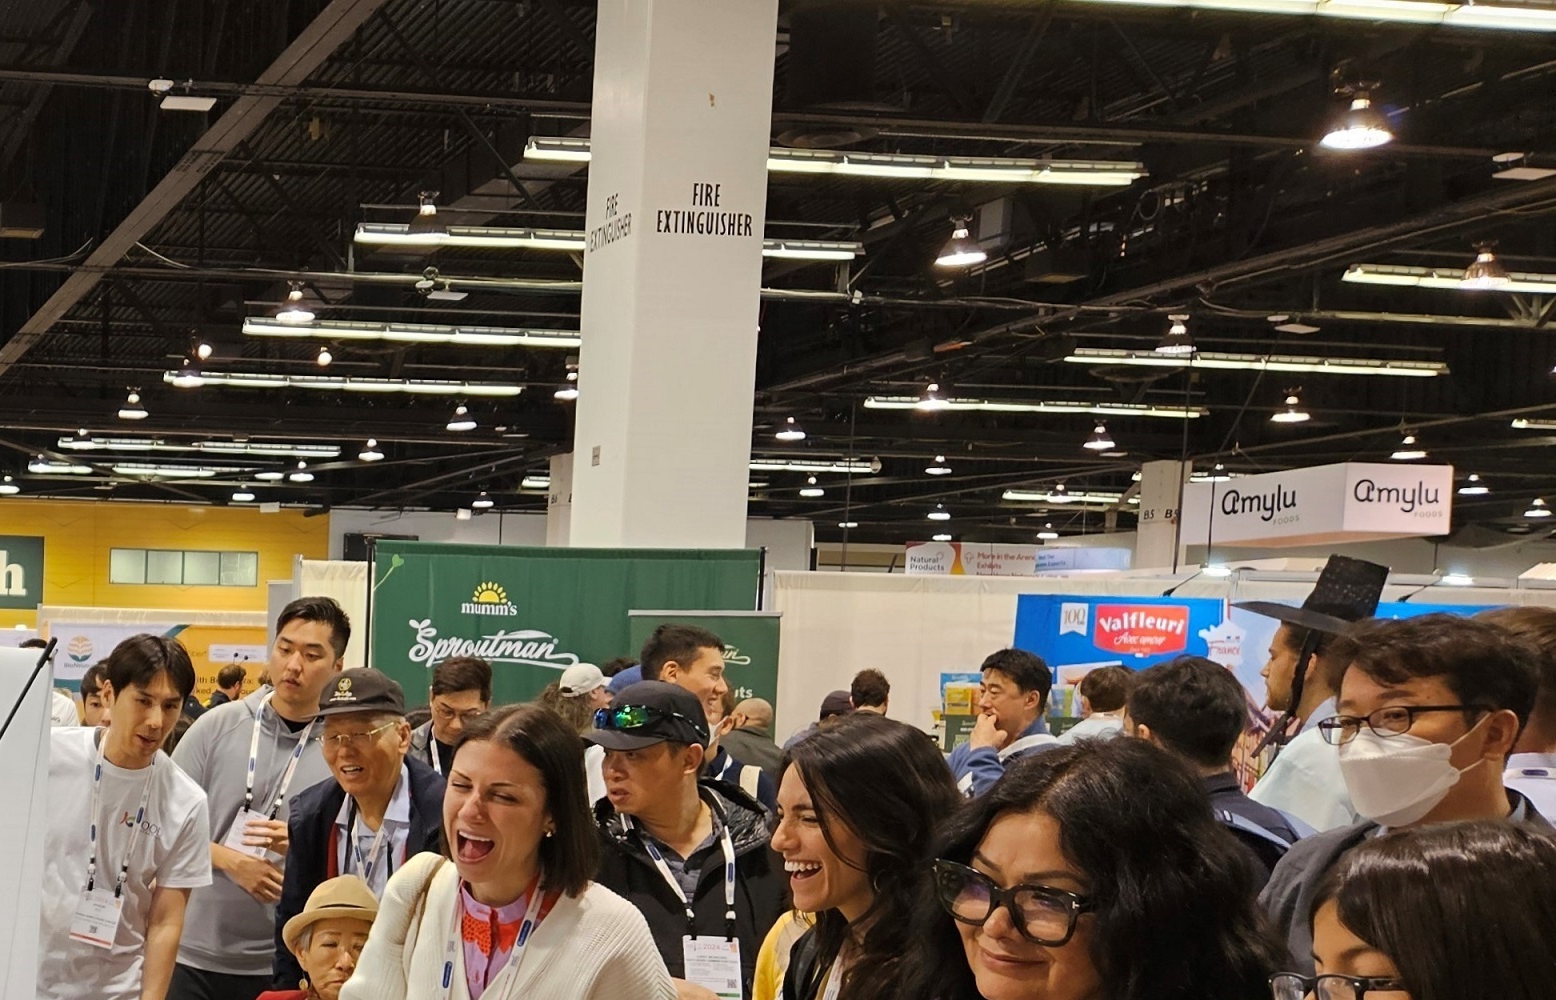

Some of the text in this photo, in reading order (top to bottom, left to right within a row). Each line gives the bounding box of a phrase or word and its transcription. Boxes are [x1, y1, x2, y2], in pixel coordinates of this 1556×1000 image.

[605, 193, 619, 219] FIRE
[692, 182, 721, 207] FIRE
[590, 213, 632, 253] EXTINGUISHER
[656, 209, 753, 237] EXTINGUISHER
[1272, 514, 1301, 525] FOODS
[1413, 510, 1444, 518] FOODS
[461, 601, 518, 616] mumm's
[1099, 611, 1186, 635] Valfleuri
[408, 619, 579, 669] Sproutman
